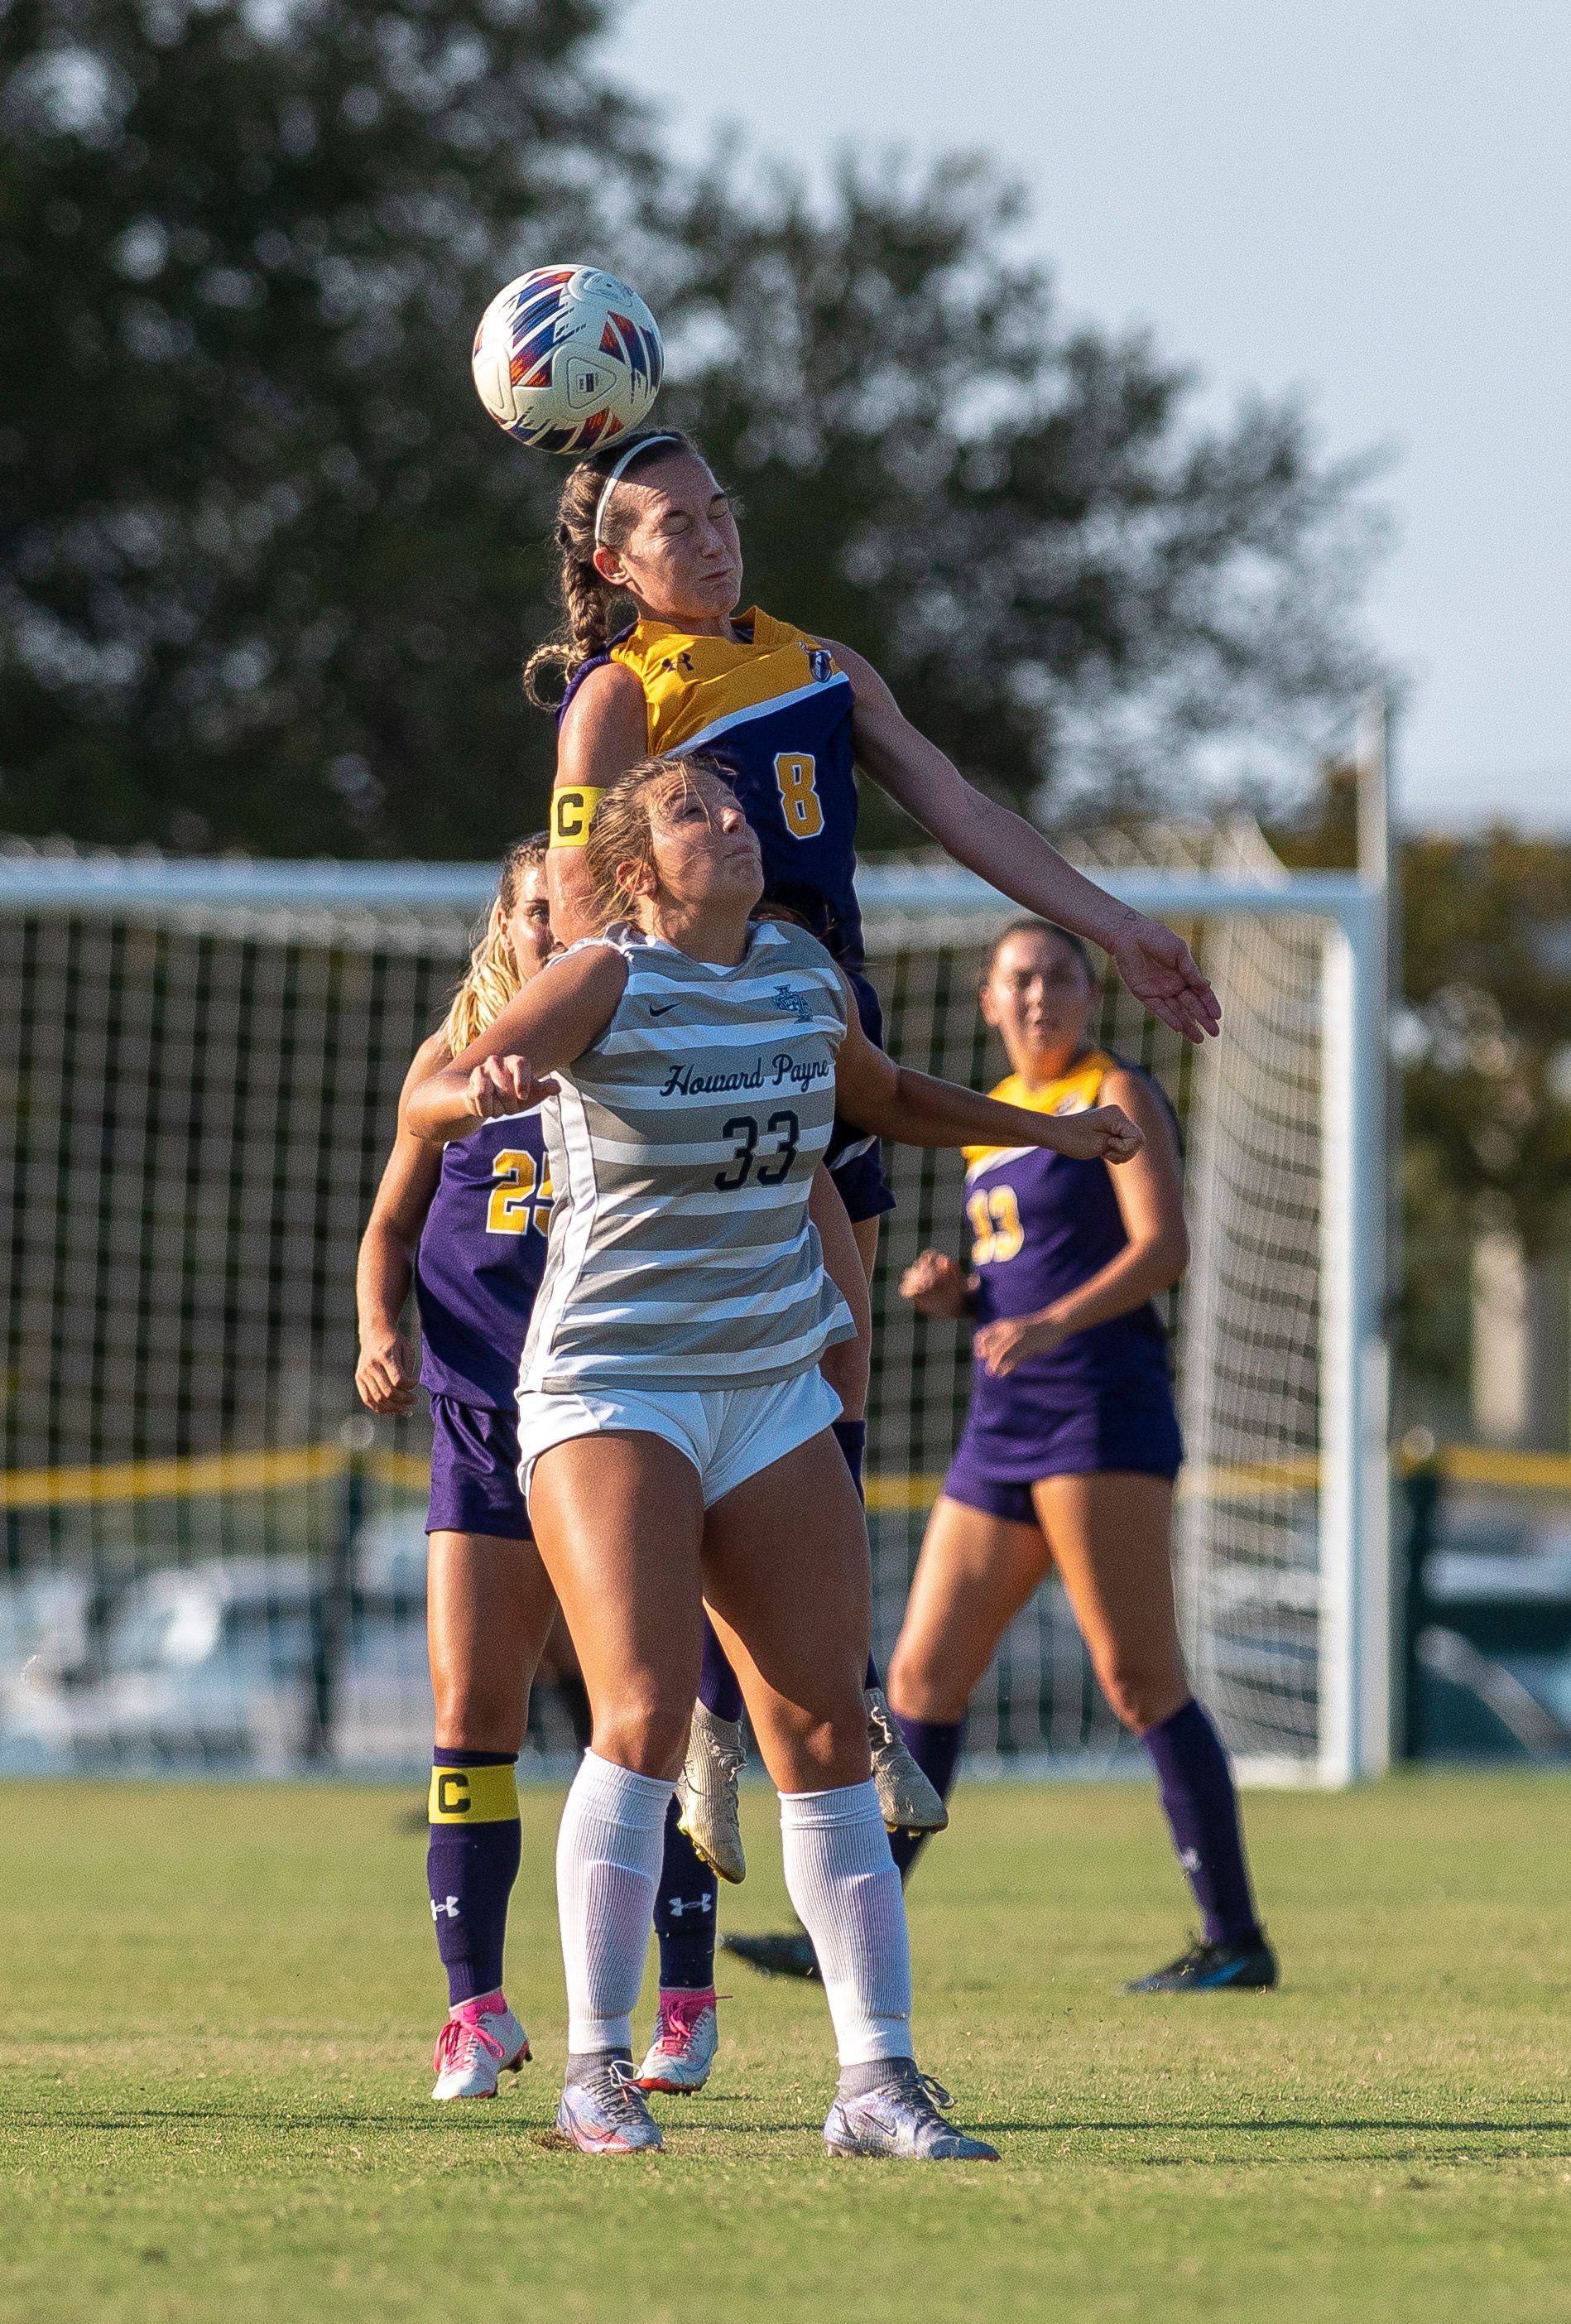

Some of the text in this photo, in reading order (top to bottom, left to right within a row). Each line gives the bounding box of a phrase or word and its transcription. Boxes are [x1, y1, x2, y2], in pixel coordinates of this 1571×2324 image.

[557, 792, 584, 837] C
[773, 752, 825, 840] 8
[660, 1053, 829, 1097] Howard Payne
[714, 1110, 800, 1191] 33
[438, 1773, 472, 1814] C
